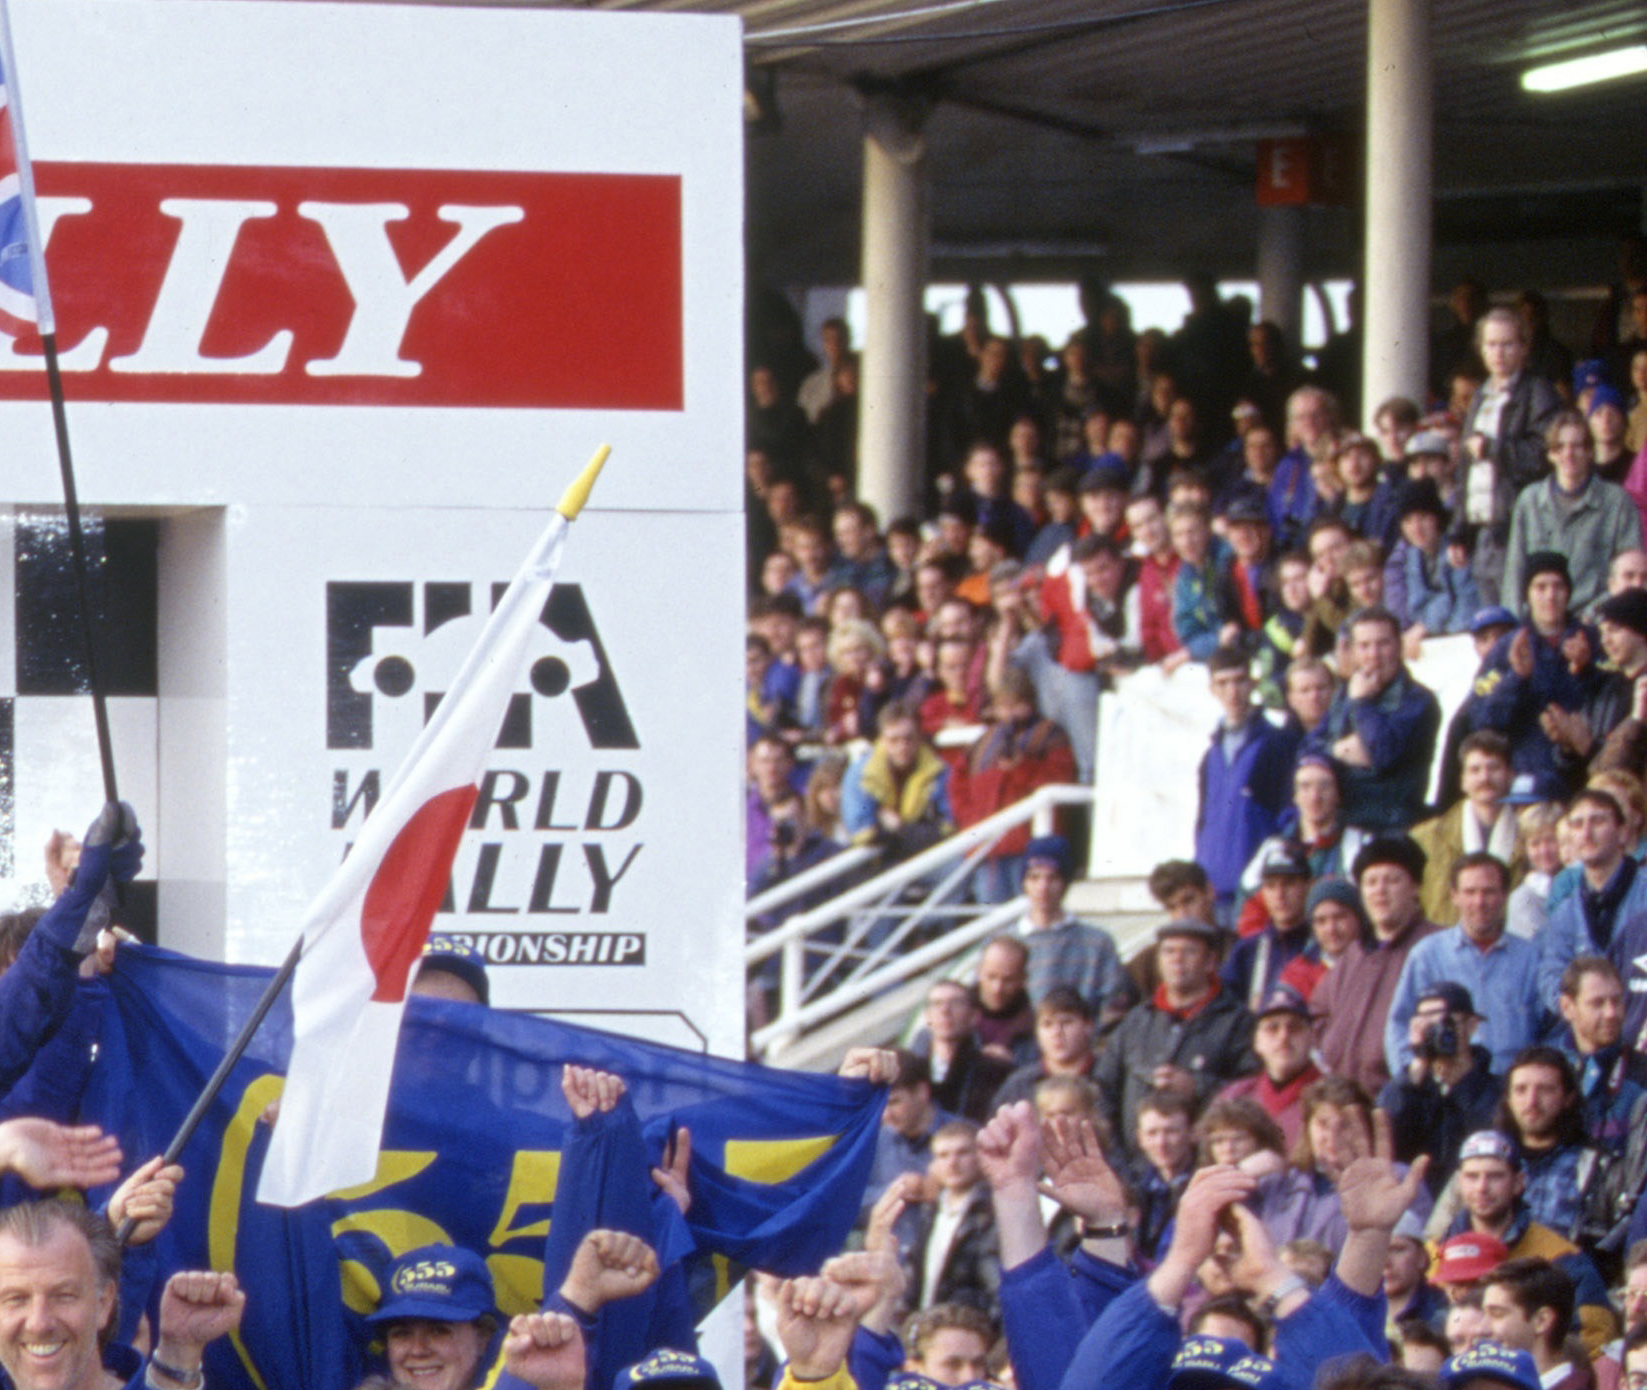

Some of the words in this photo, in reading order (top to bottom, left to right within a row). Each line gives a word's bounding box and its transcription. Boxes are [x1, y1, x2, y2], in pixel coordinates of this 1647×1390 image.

[326, 581, 641, 750] FIA
[331, 769, 645, 830] WRLD
[343, 843, 644, 914] LLY
[399, 1261, 456, 1286] 555
